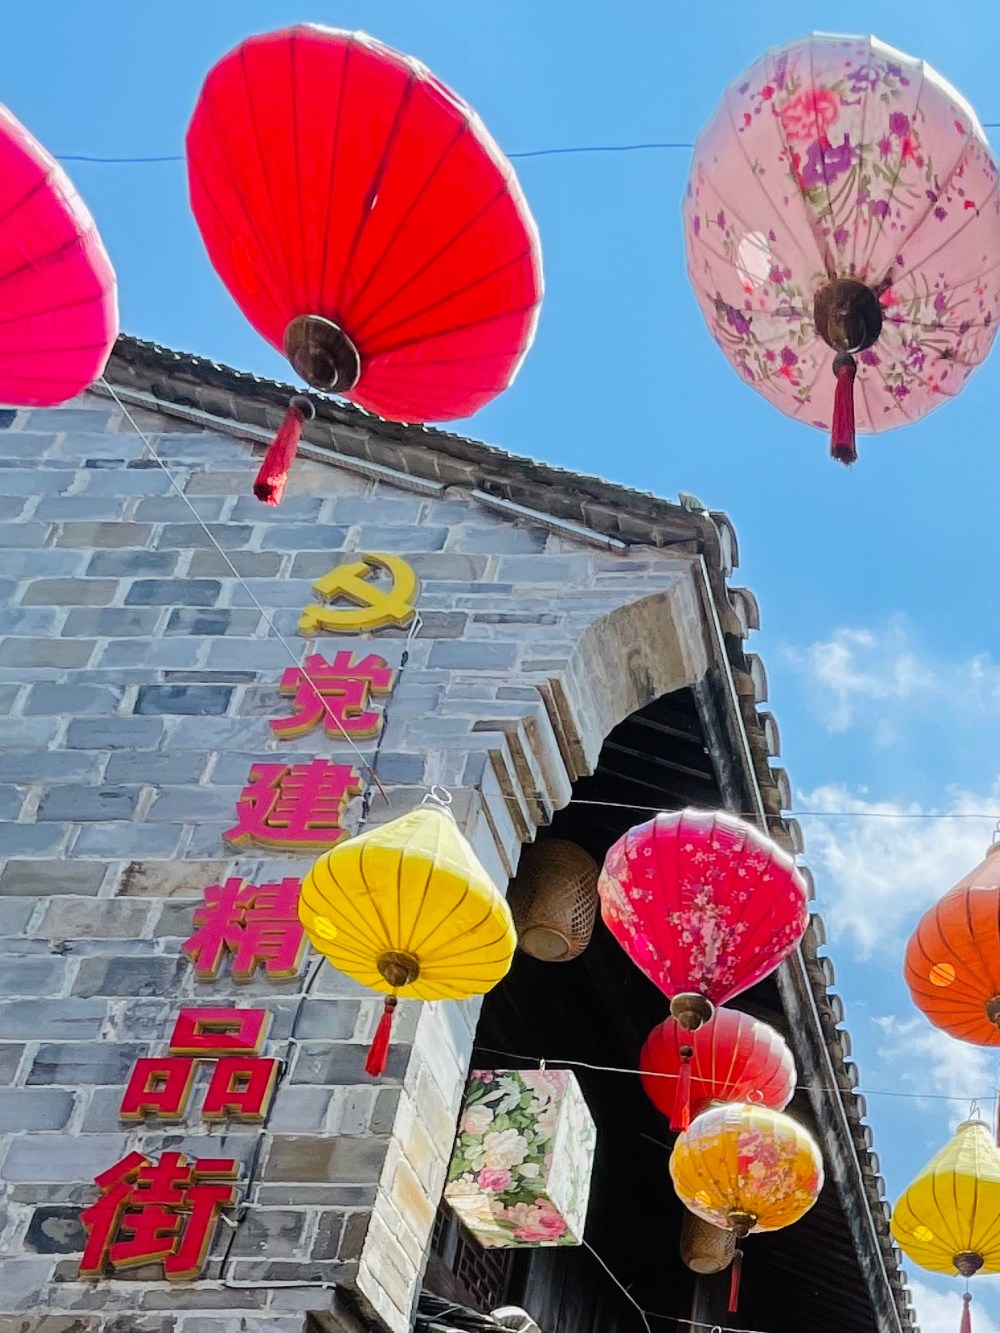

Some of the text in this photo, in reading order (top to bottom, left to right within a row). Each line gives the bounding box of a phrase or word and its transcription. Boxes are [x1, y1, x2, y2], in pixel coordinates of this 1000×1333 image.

[78, 650, 396, 1280] 党建精品街
